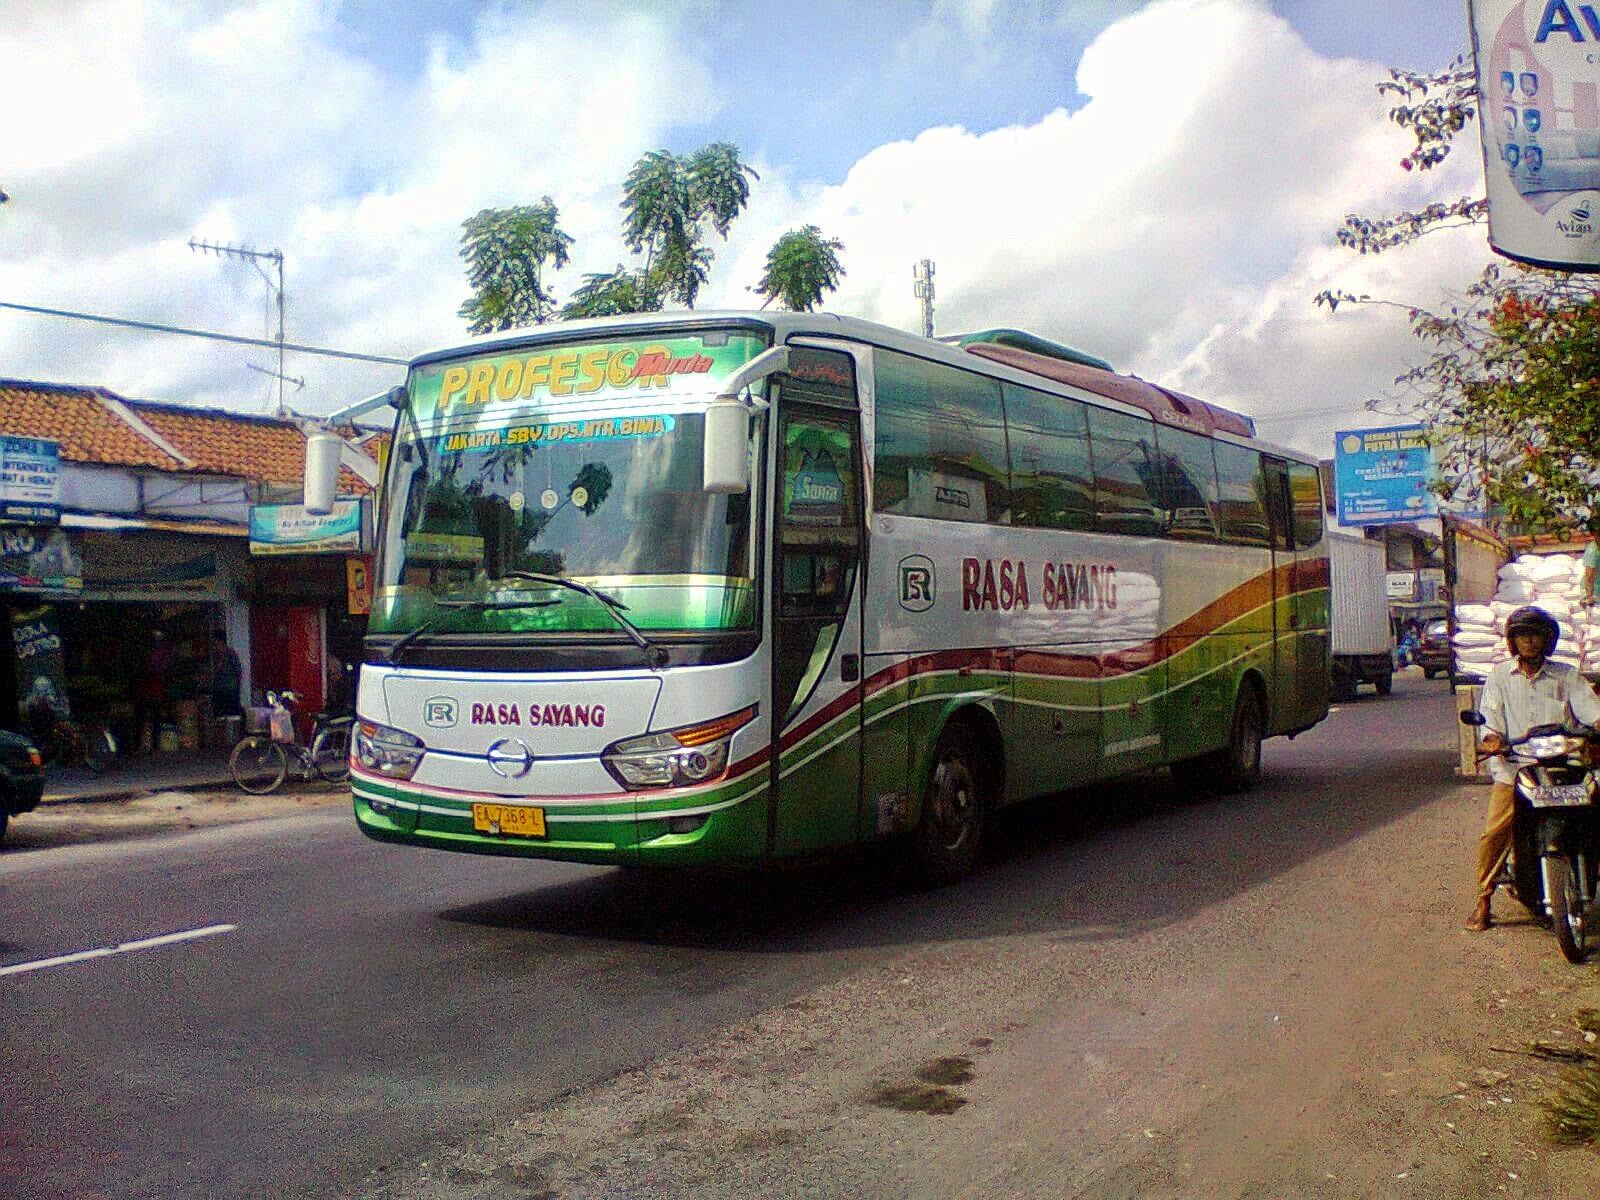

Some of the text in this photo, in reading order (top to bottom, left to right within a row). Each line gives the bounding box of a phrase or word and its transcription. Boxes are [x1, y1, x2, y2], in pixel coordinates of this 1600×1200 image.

[962, 557, 1030, 612] RASA
[1042, 561, 1118, 611] SAYANG
[471, 702, 521, 726] RASA
[529, 703, 606, 728] SAYANG
